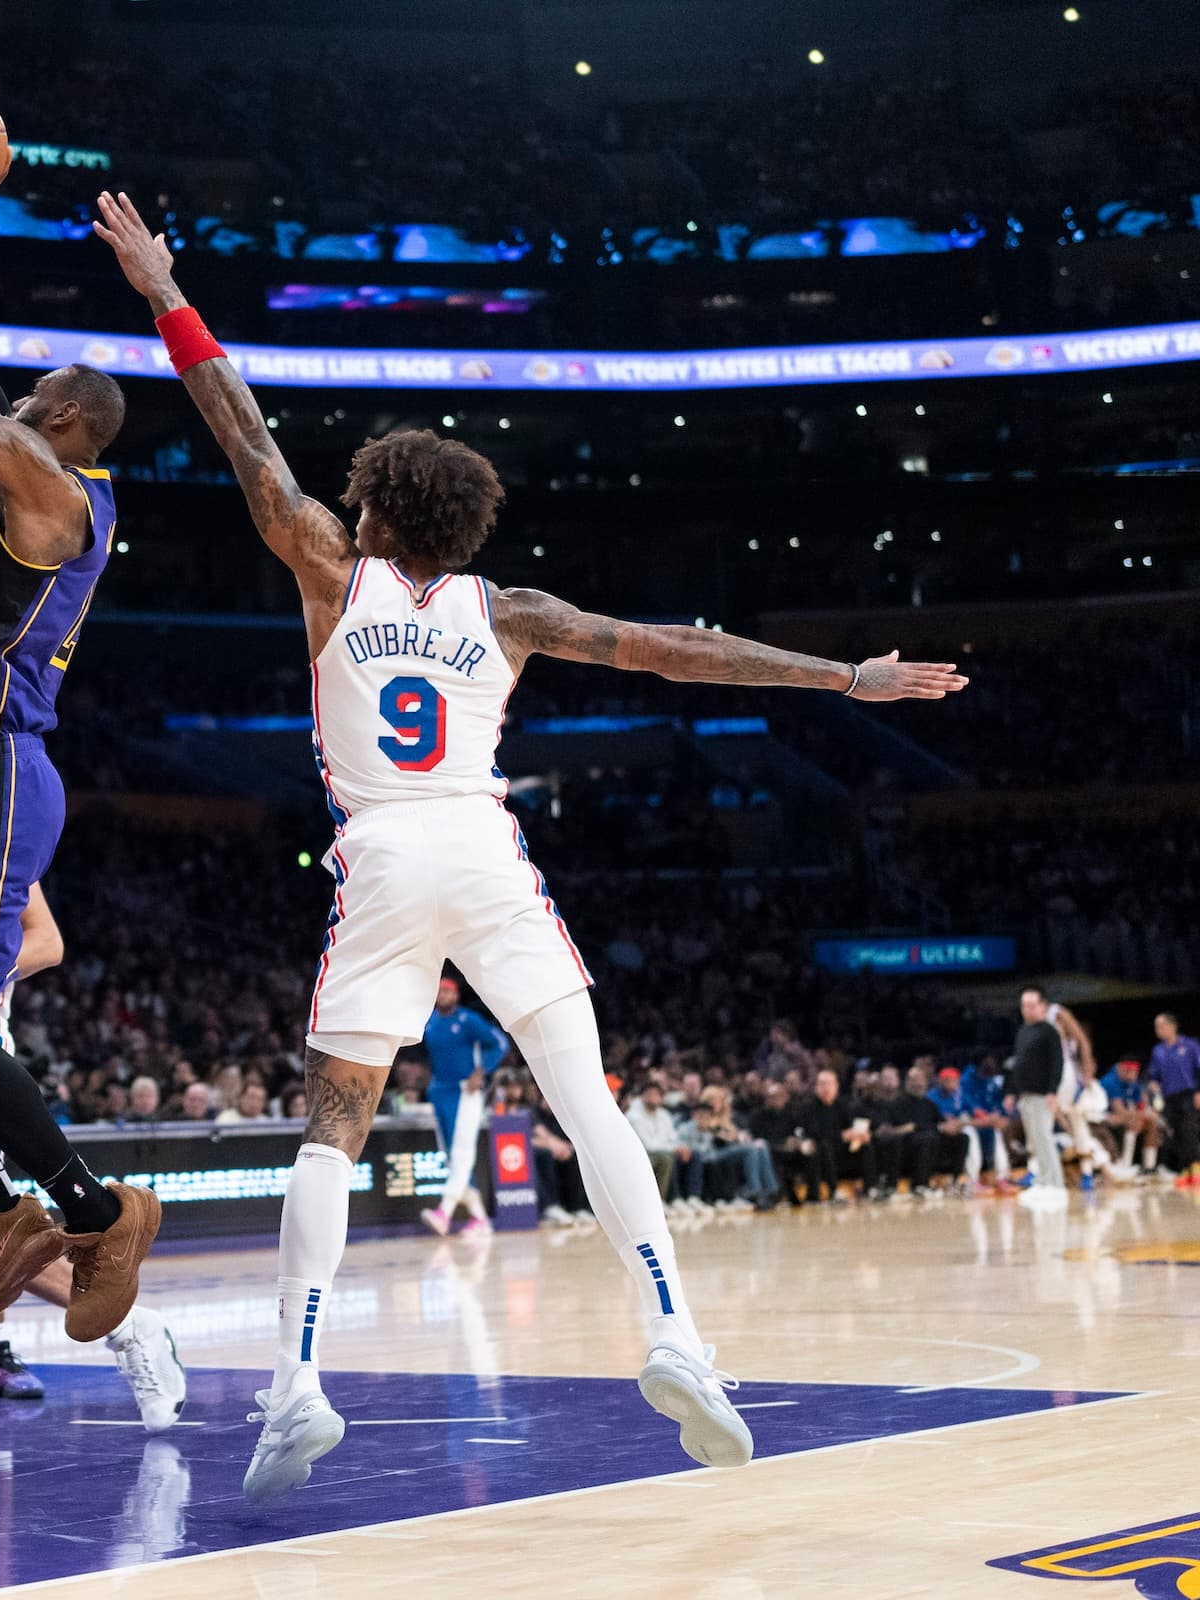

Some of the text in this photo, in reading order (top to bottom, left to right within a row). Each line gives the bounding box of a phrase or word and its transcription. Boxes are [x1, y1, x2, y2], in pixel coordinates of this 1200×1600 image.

[1061, 331, 1169, 364] VICTORY
[246, 353, 325, 378] TASTES
[328, 357, 379, 379] LIKE
[383, 358, 452, 381] TACOS
[595, 349, 911, 382] VICTORY TASTES LIKE TACOS
[345, 623, 442, 664] OUBRE
[377, 675, 447, 772] 9
